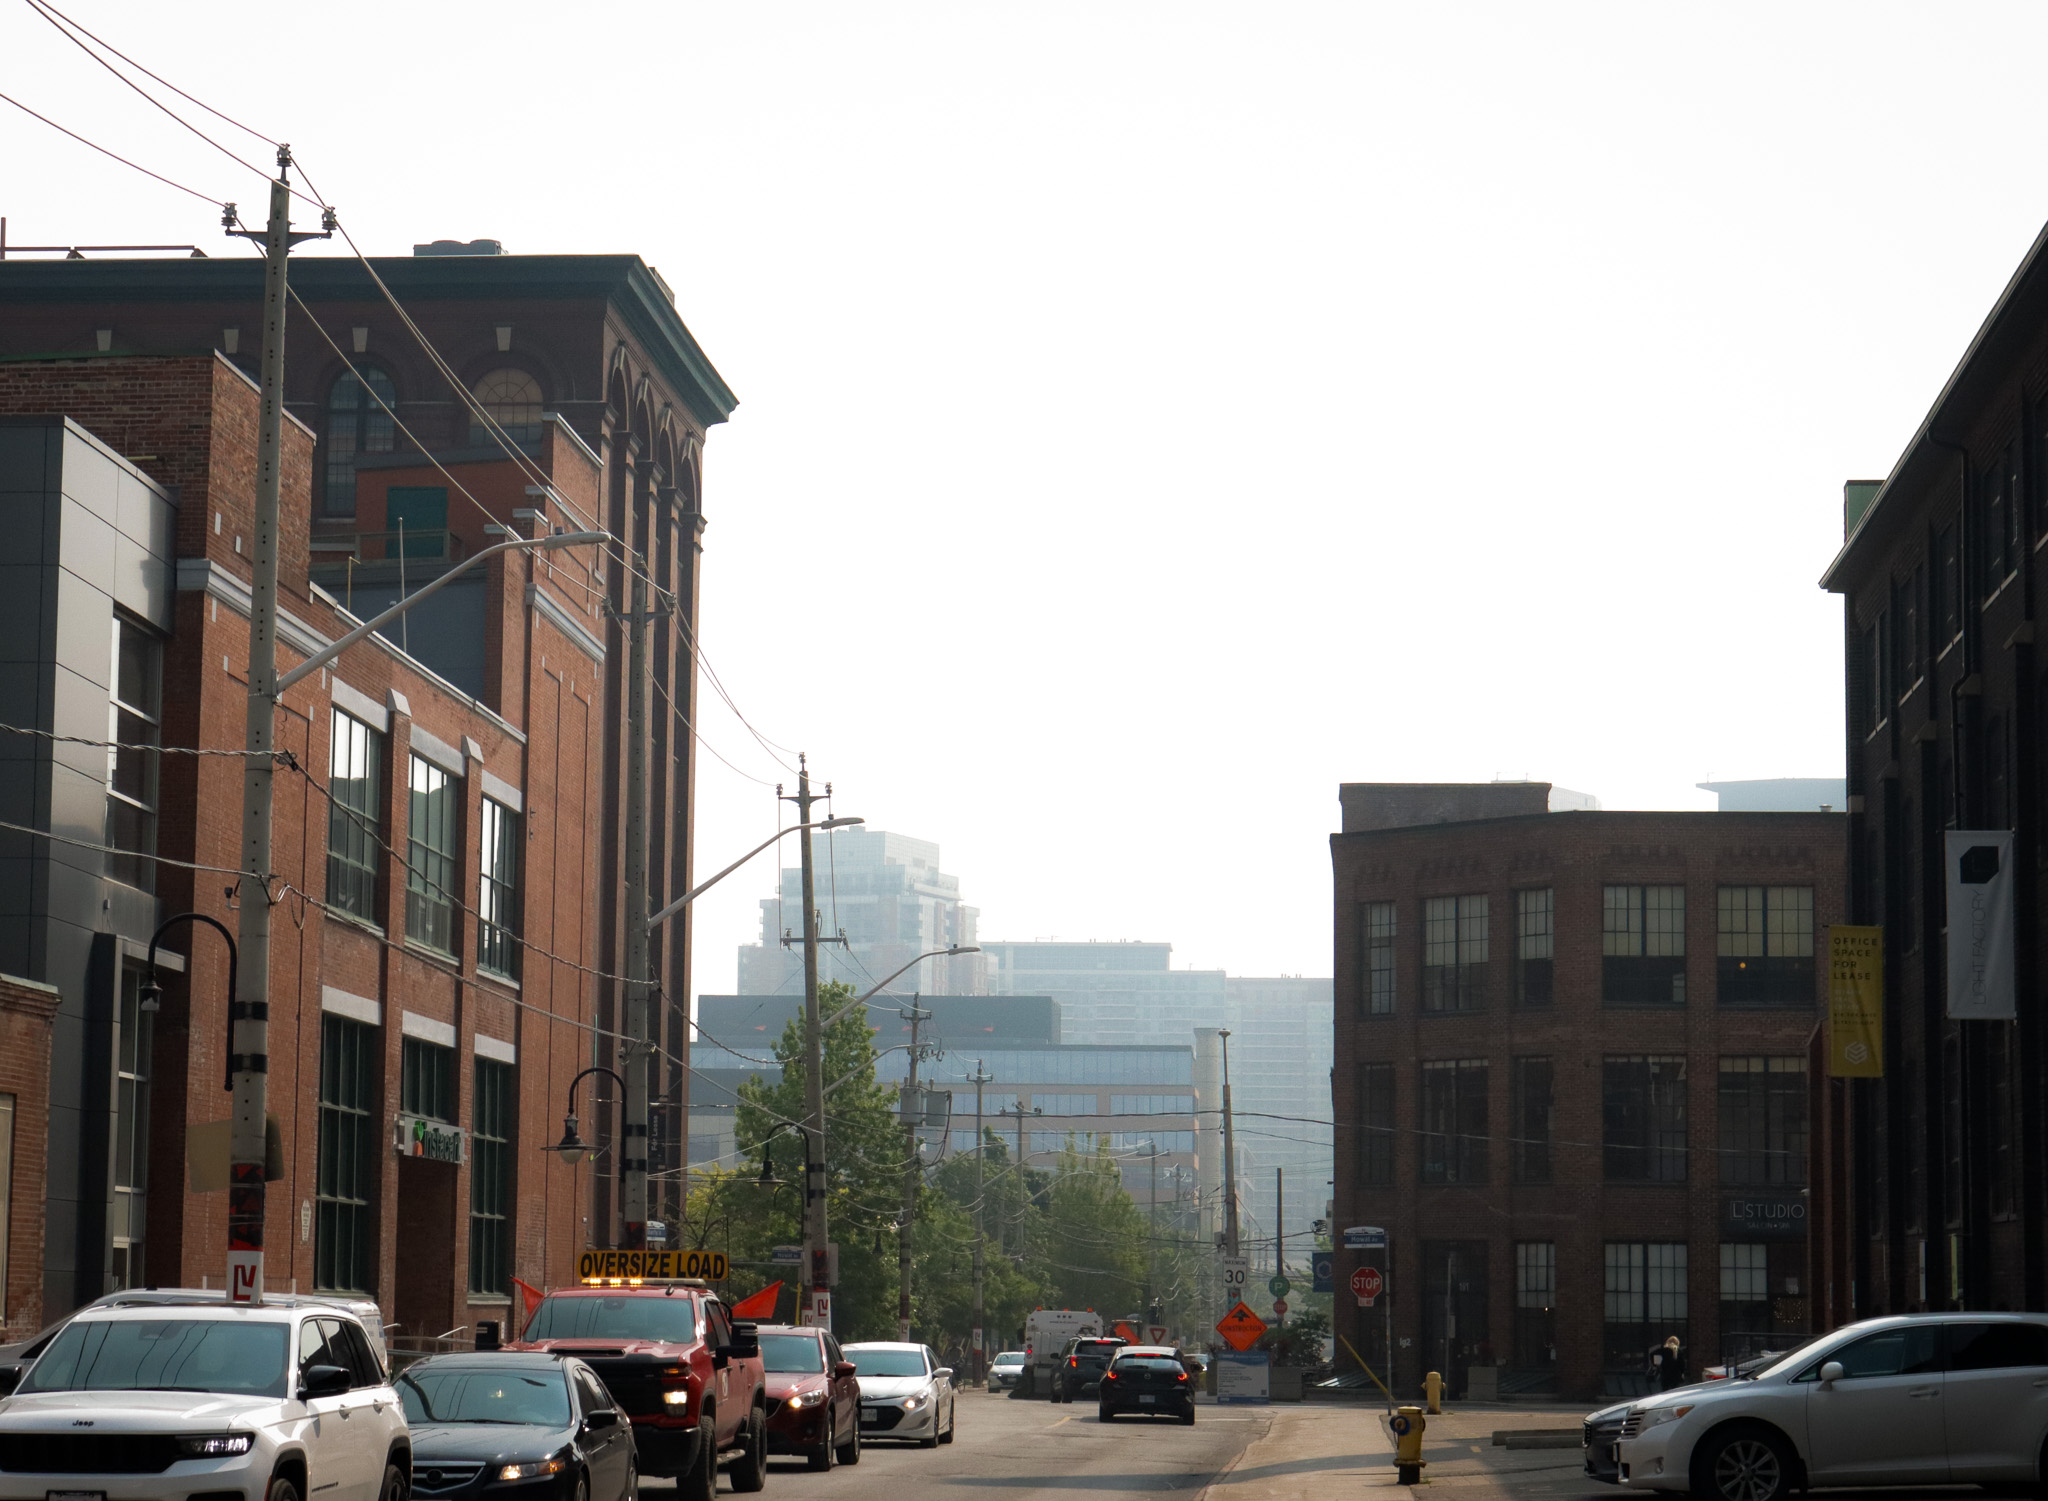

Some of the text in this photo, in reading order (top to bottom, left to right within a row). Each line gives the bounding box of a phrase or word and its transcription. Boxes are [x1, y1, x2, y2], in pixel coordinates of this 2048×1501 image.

[1833, 937, 1878, 946] OFFICE
[1971, 889, 1986, 1005] LIGHT FACTORY
[1833, 949, 1871, 957] SPACE
[1833, 960, 1857, 968] FOR
[1833, 972, 1871, 980] LEASE
[580, 1252, 726, 1279] OVERSIZE LOAD
[1224, 1269, 1245, 1284] 30
[1274, 1282, 1283, 1291] P
[1353, 1277, 1380, 1289] STOP
[72, 1419, 94, 1427] Jeep
